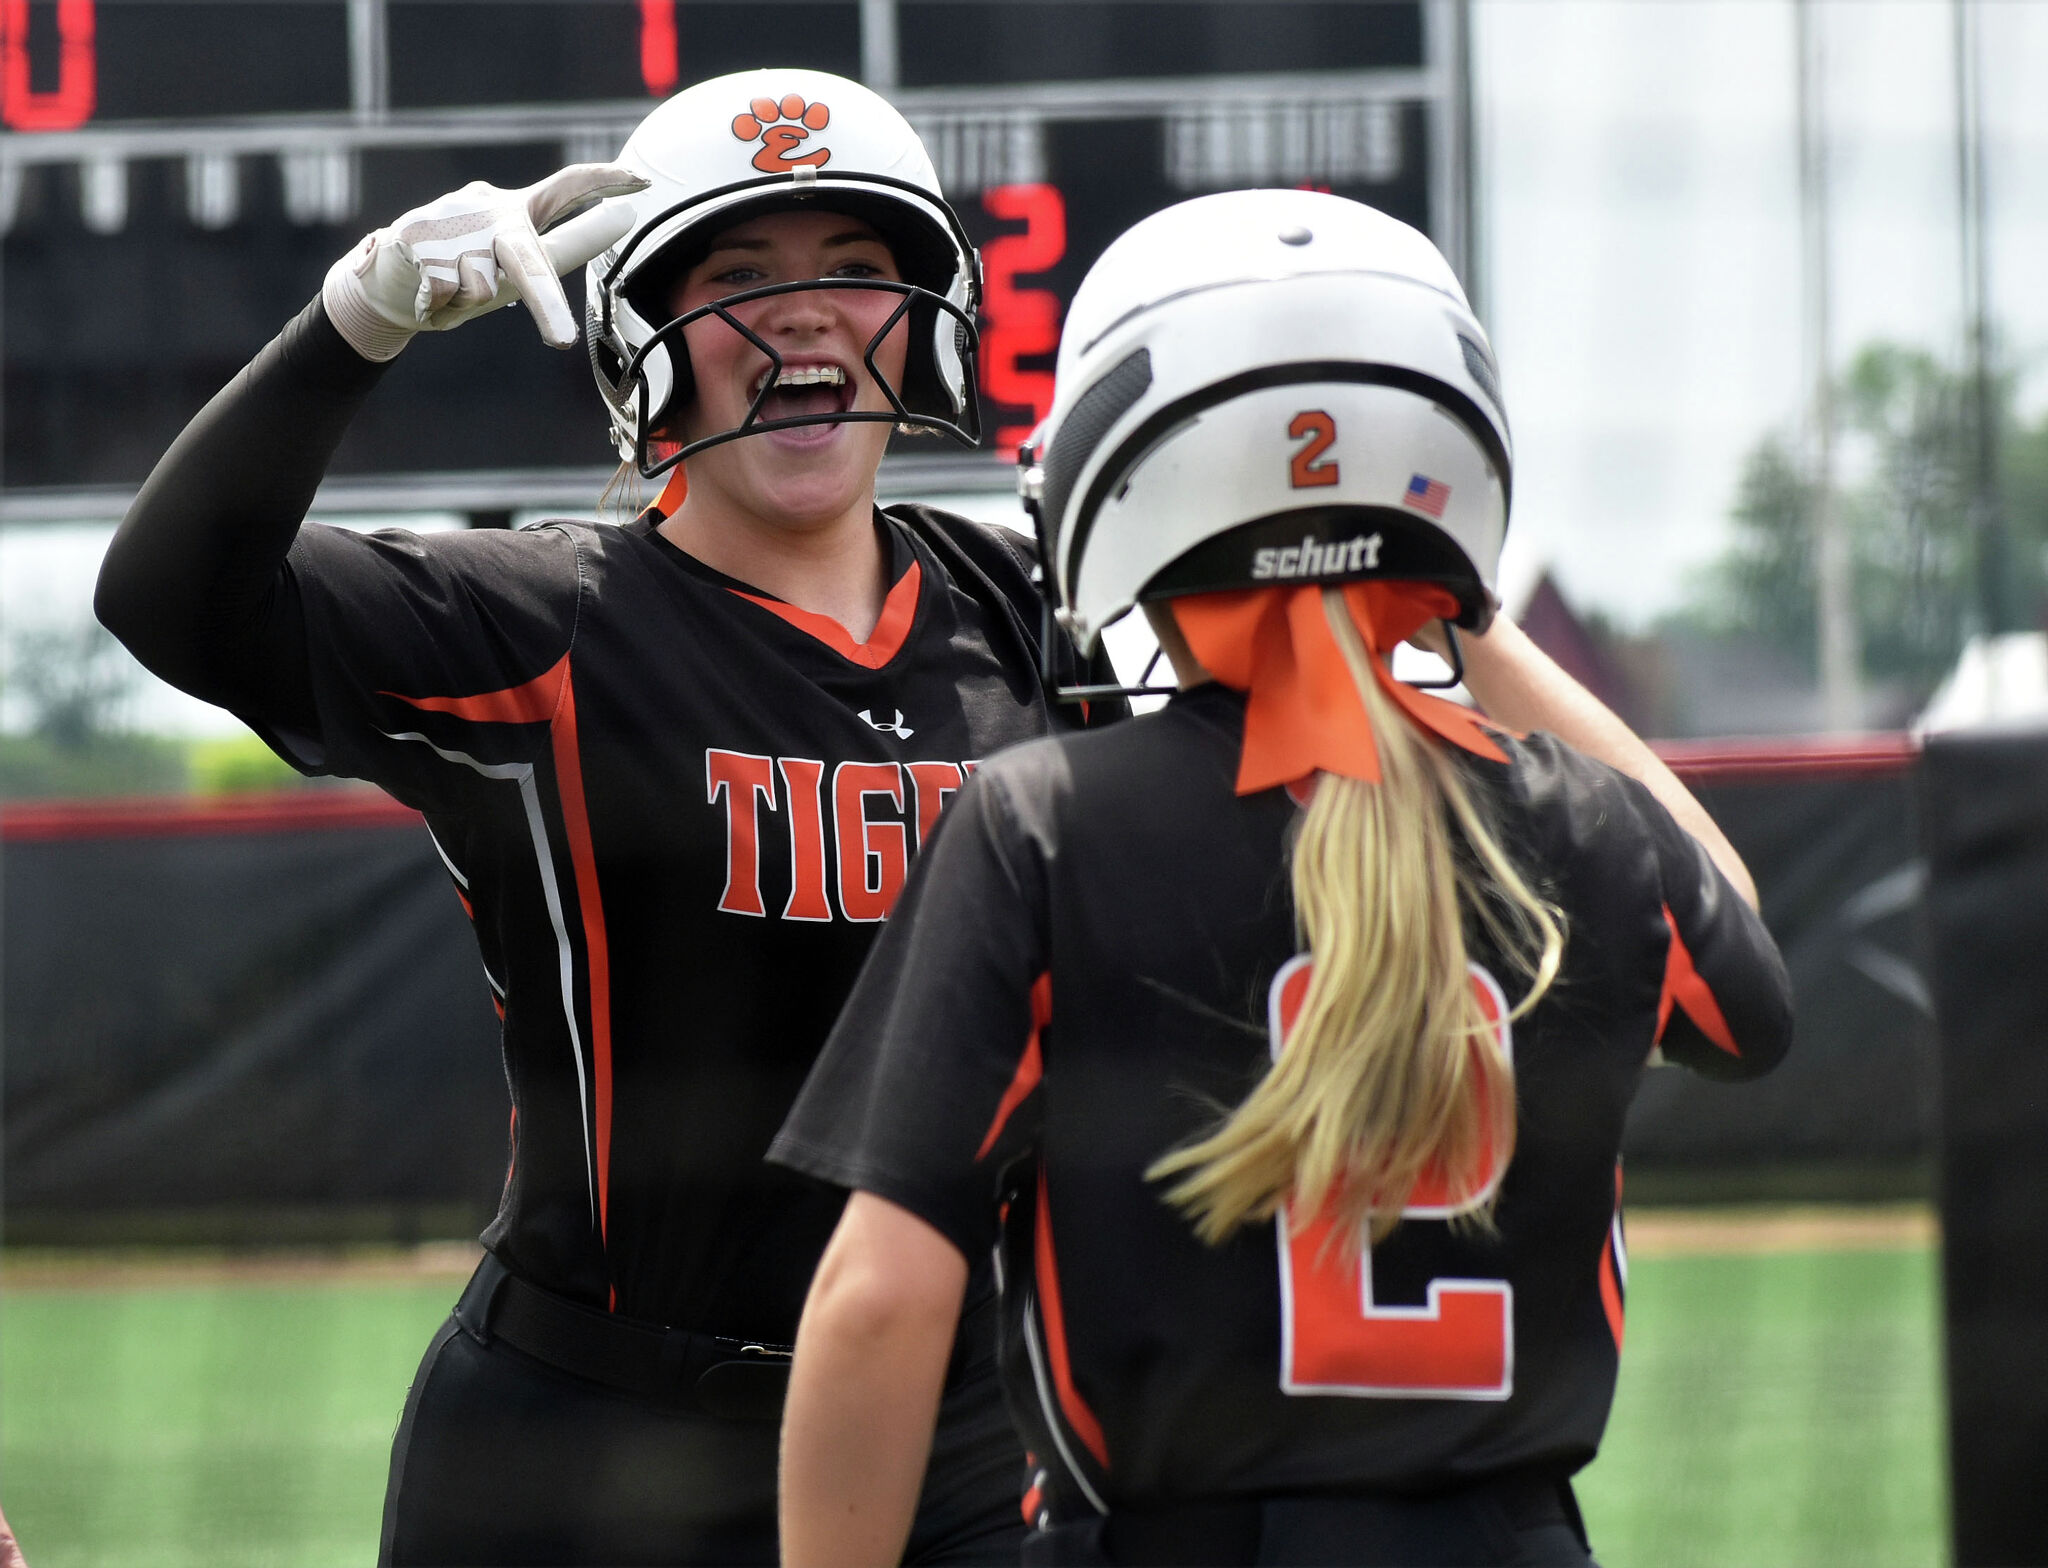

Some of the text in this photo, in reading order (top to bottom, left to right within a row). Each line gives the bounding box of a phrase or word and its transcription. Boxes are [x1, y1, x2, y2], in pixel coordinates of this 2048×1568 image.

[1287, 410, 1340, 489] 2
[1252, 532, 1383, 579] schutt
[705, 747, 983, 923] TIG
[1268, 953, 1515, 1401] 2
